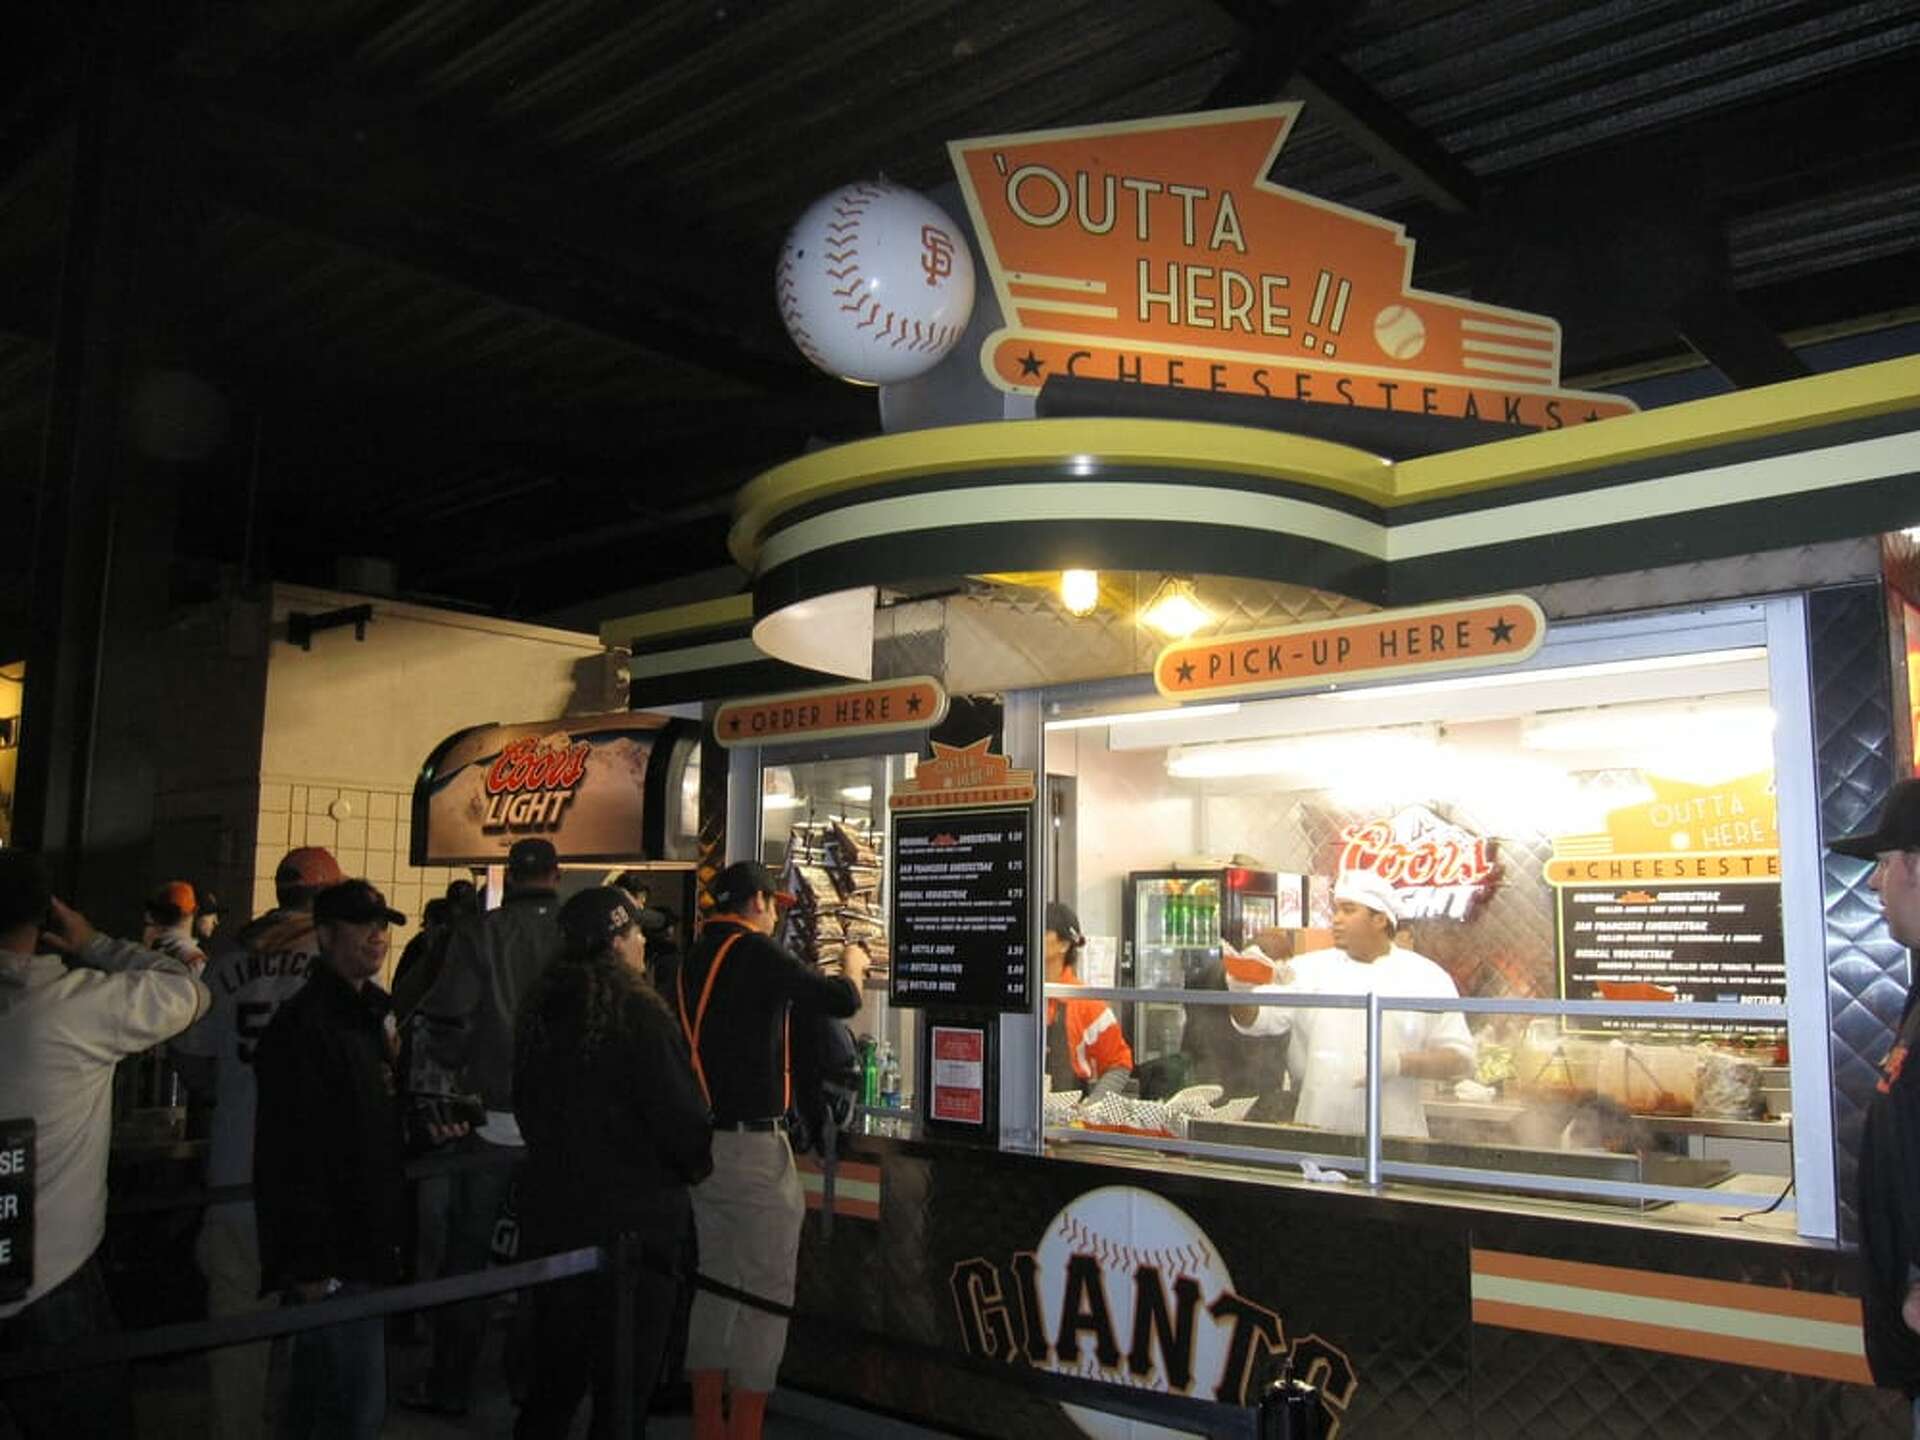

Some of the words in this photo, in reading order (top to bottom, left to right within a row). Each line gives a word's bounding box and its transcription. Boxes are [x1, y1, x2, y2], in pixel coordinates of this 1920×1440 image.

[1137, 257, 1291, 338] HERE
[1066, 351, 1563, 431] CHEESESTEAKS
[1208, 635, 1352, 680] PICK-UP
[1379, 620, 1472, 657] HERE
[751, 705, 821, 732] ORDER
[835, 696, 891, 723] HERE
[487, 735, 591, 795] Coors
[484, 790, 572, 826] LIGHT
[1650, 793, 1746, 829] OUTTA
[1702, 818, 1767, 849] HERE
[1340, 818, 1494, 886] Coors
[0, 1195, 18, 1219] R
[950, 1250, 1359, 1440] GIANTS
